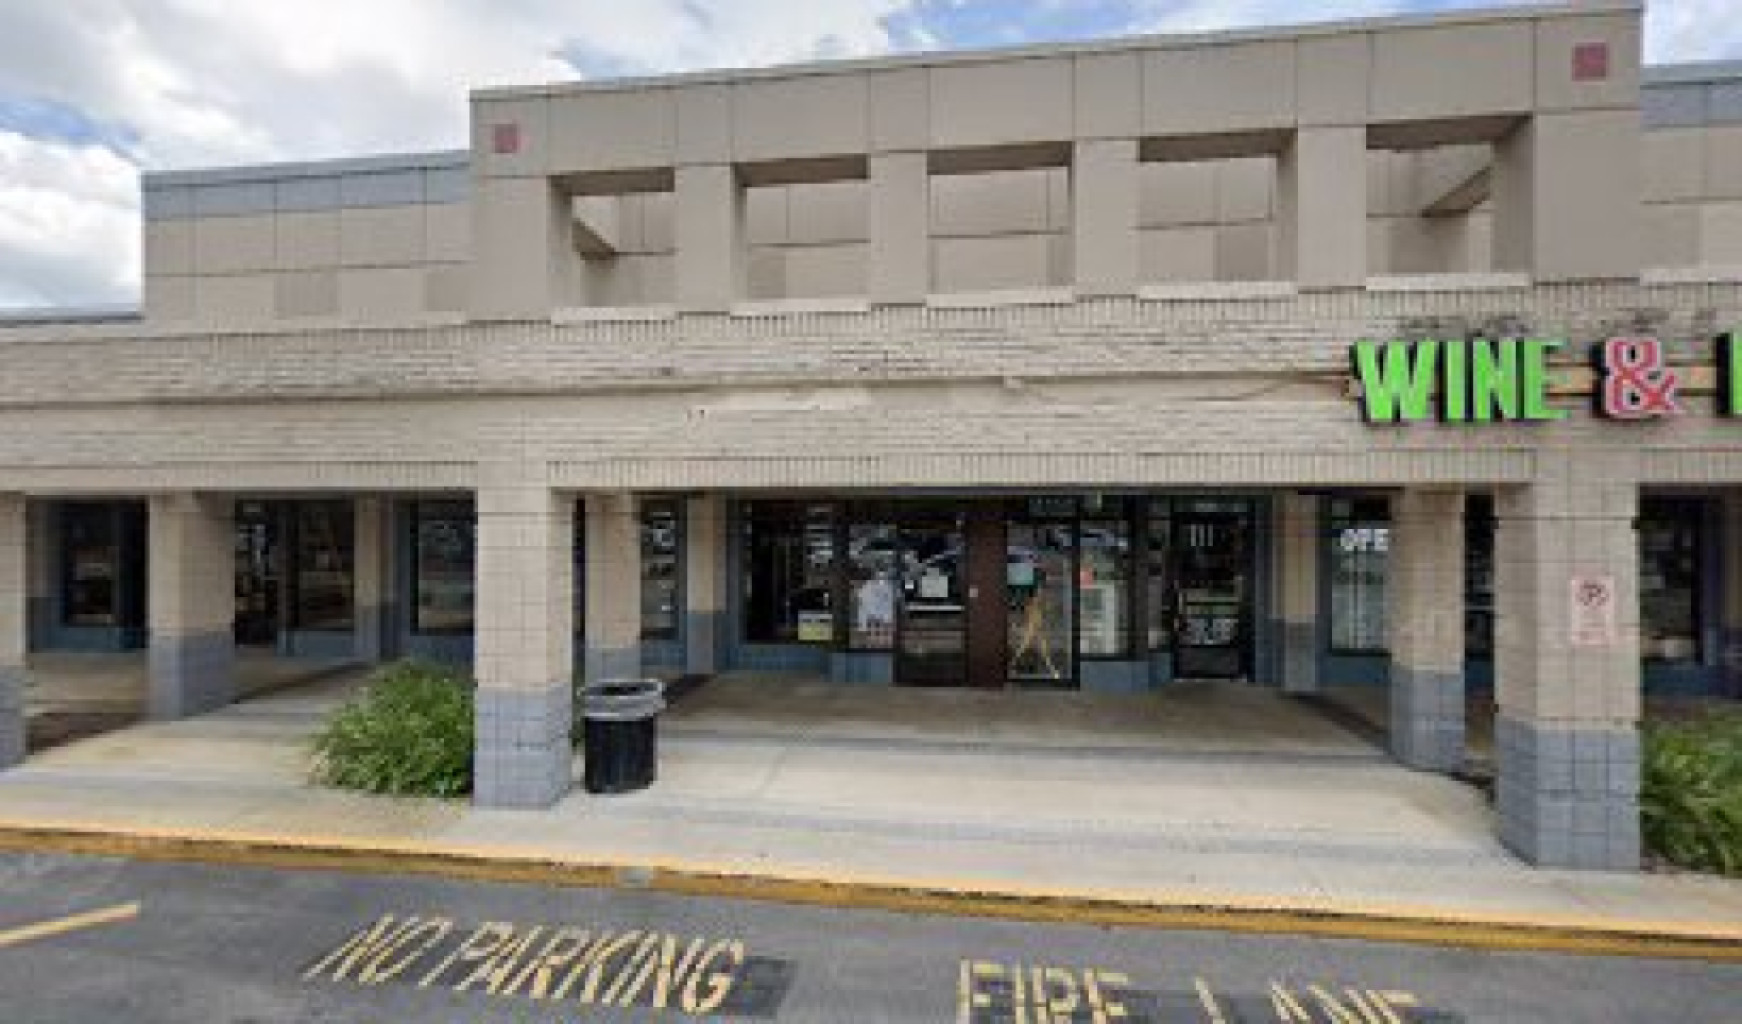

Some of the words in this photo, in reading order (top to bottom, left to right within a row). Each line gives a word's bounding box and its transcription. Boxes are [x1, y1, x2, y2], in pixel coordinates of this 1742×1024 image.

[1352, 336, 1570, 423] WINE
[1600, 337, 1682, 419] &
[1340, 528, 1389, 551] OPE
[302, 914, 453, 983] NO
[418, 923, 745, 1014] PARKING
[956, 959, 1130, 1024] FIRE
